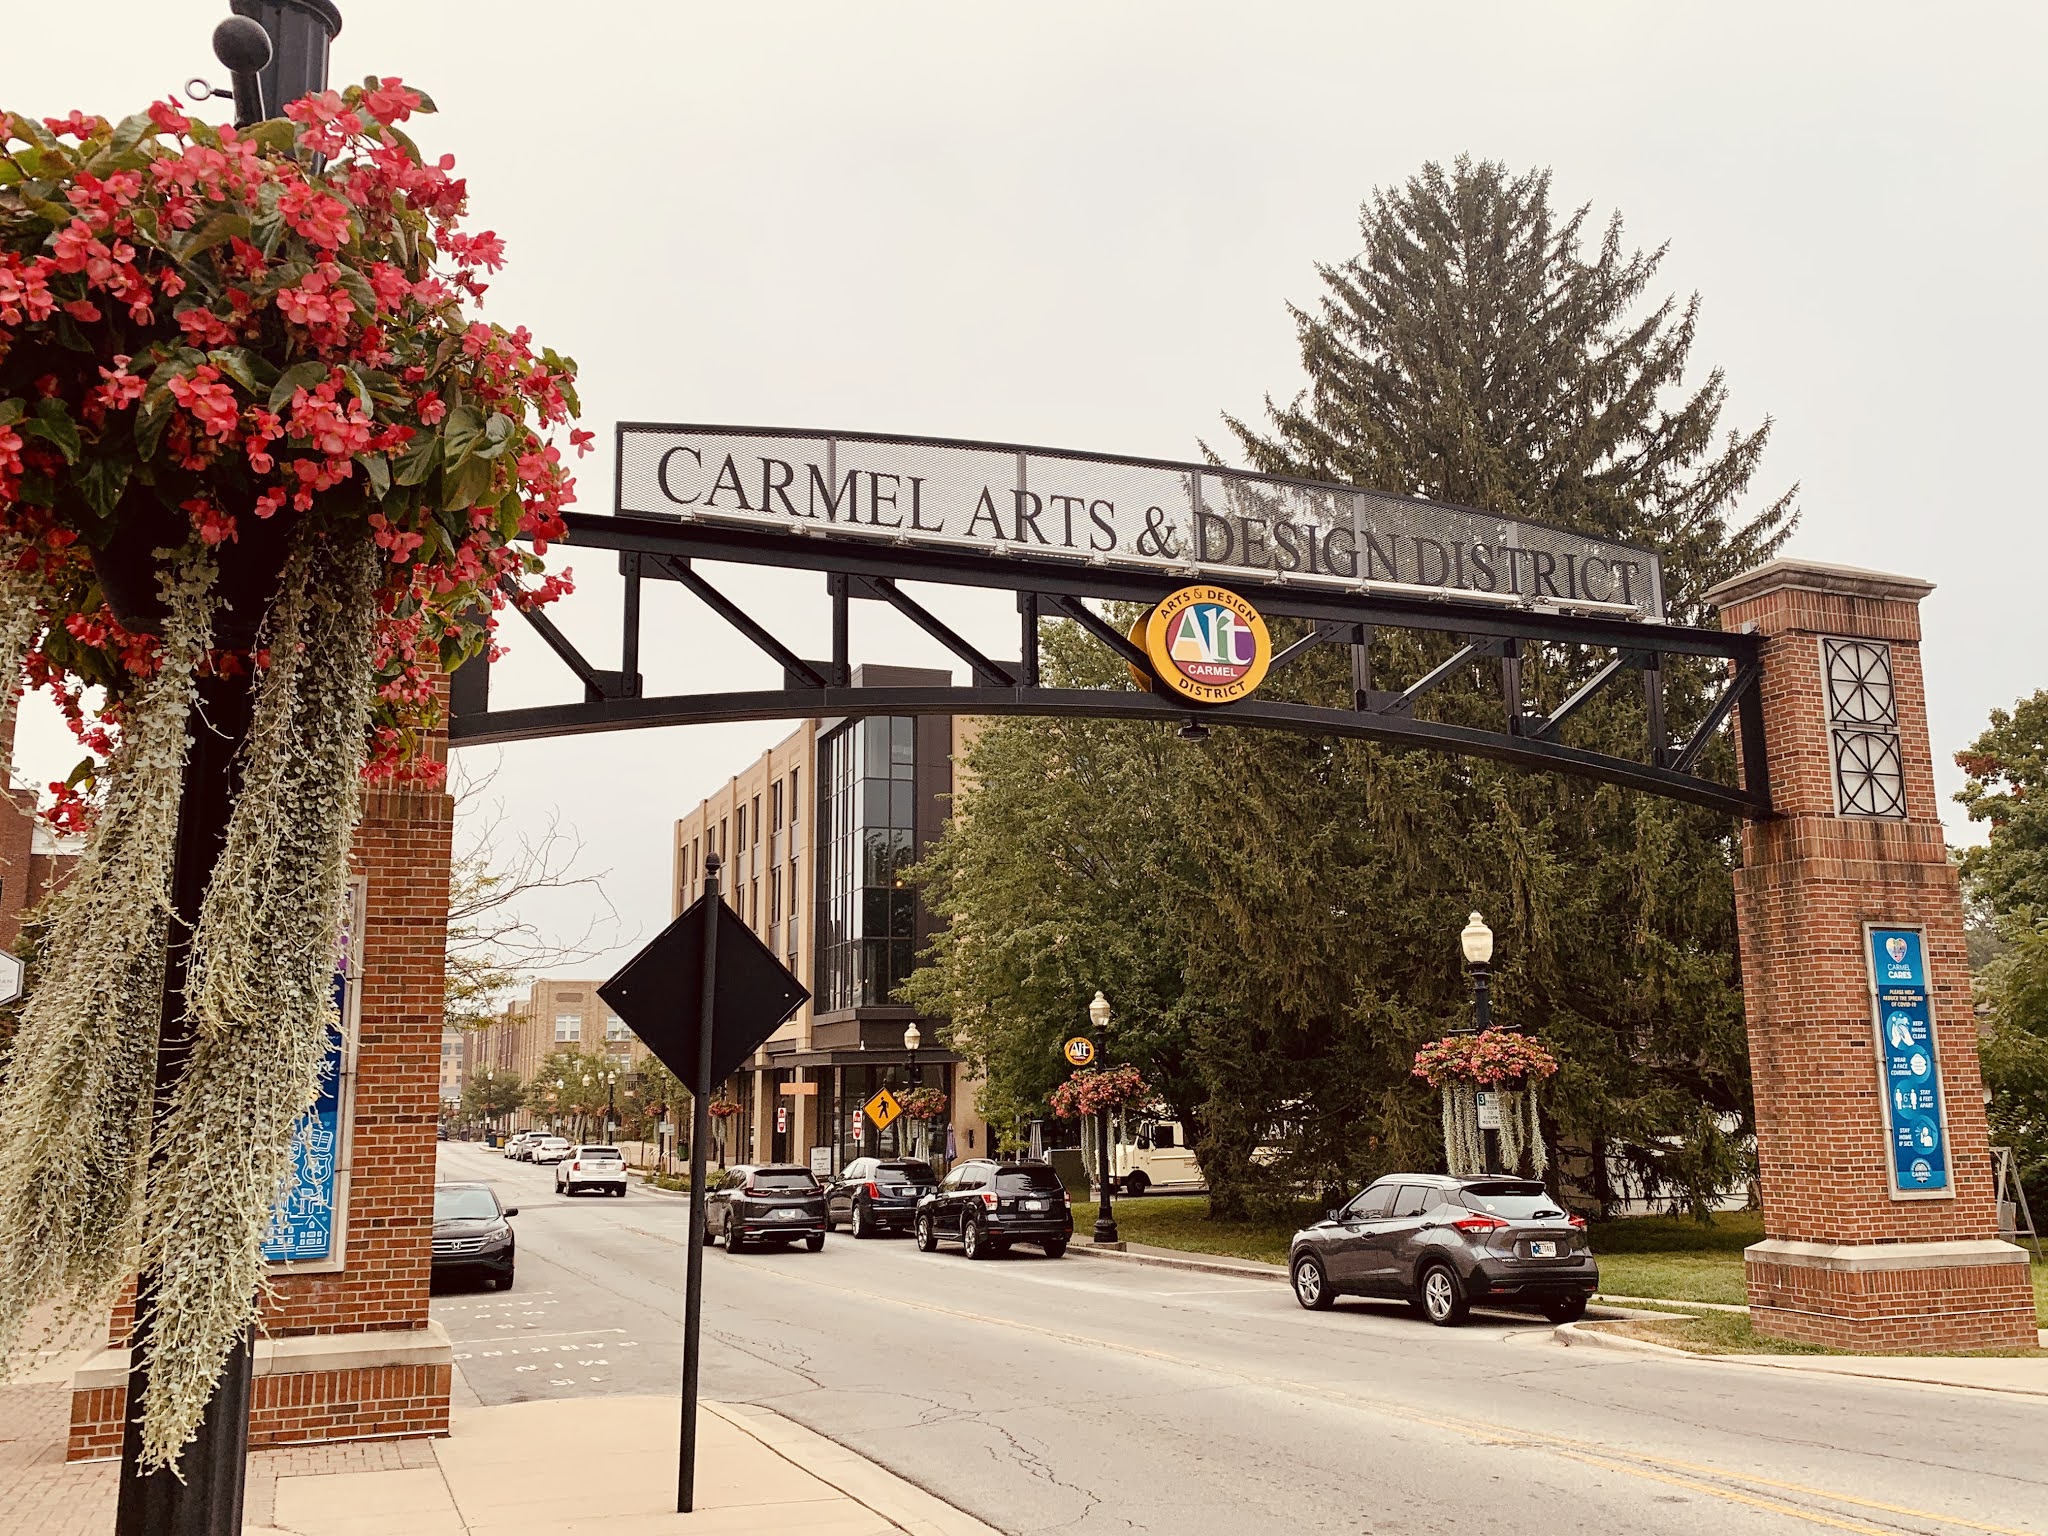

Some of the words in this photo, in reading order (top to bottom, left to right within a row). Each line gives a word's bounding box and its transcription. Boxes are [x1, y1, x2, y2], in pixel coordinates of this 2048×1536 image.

[657, 446, 945, 531] CARMEL
[965, 485, 1118, 551] ARTS
[1136, 506, 1180, 558] &
[1195, 511, 1399, 584] DESIGN
[1411, 537, 1639, 605] DISTRICT
[1160, 591, 1190, 619] ARTS
[1193, 588, 1203, 599] &
[1207, 589, 1256, 622] DESIGN
[1170, 605, 1252, 666] Art
[1188, 664, 1238, 677] CARMEL
[1178, 678, 1246, 699] DISTRICT
